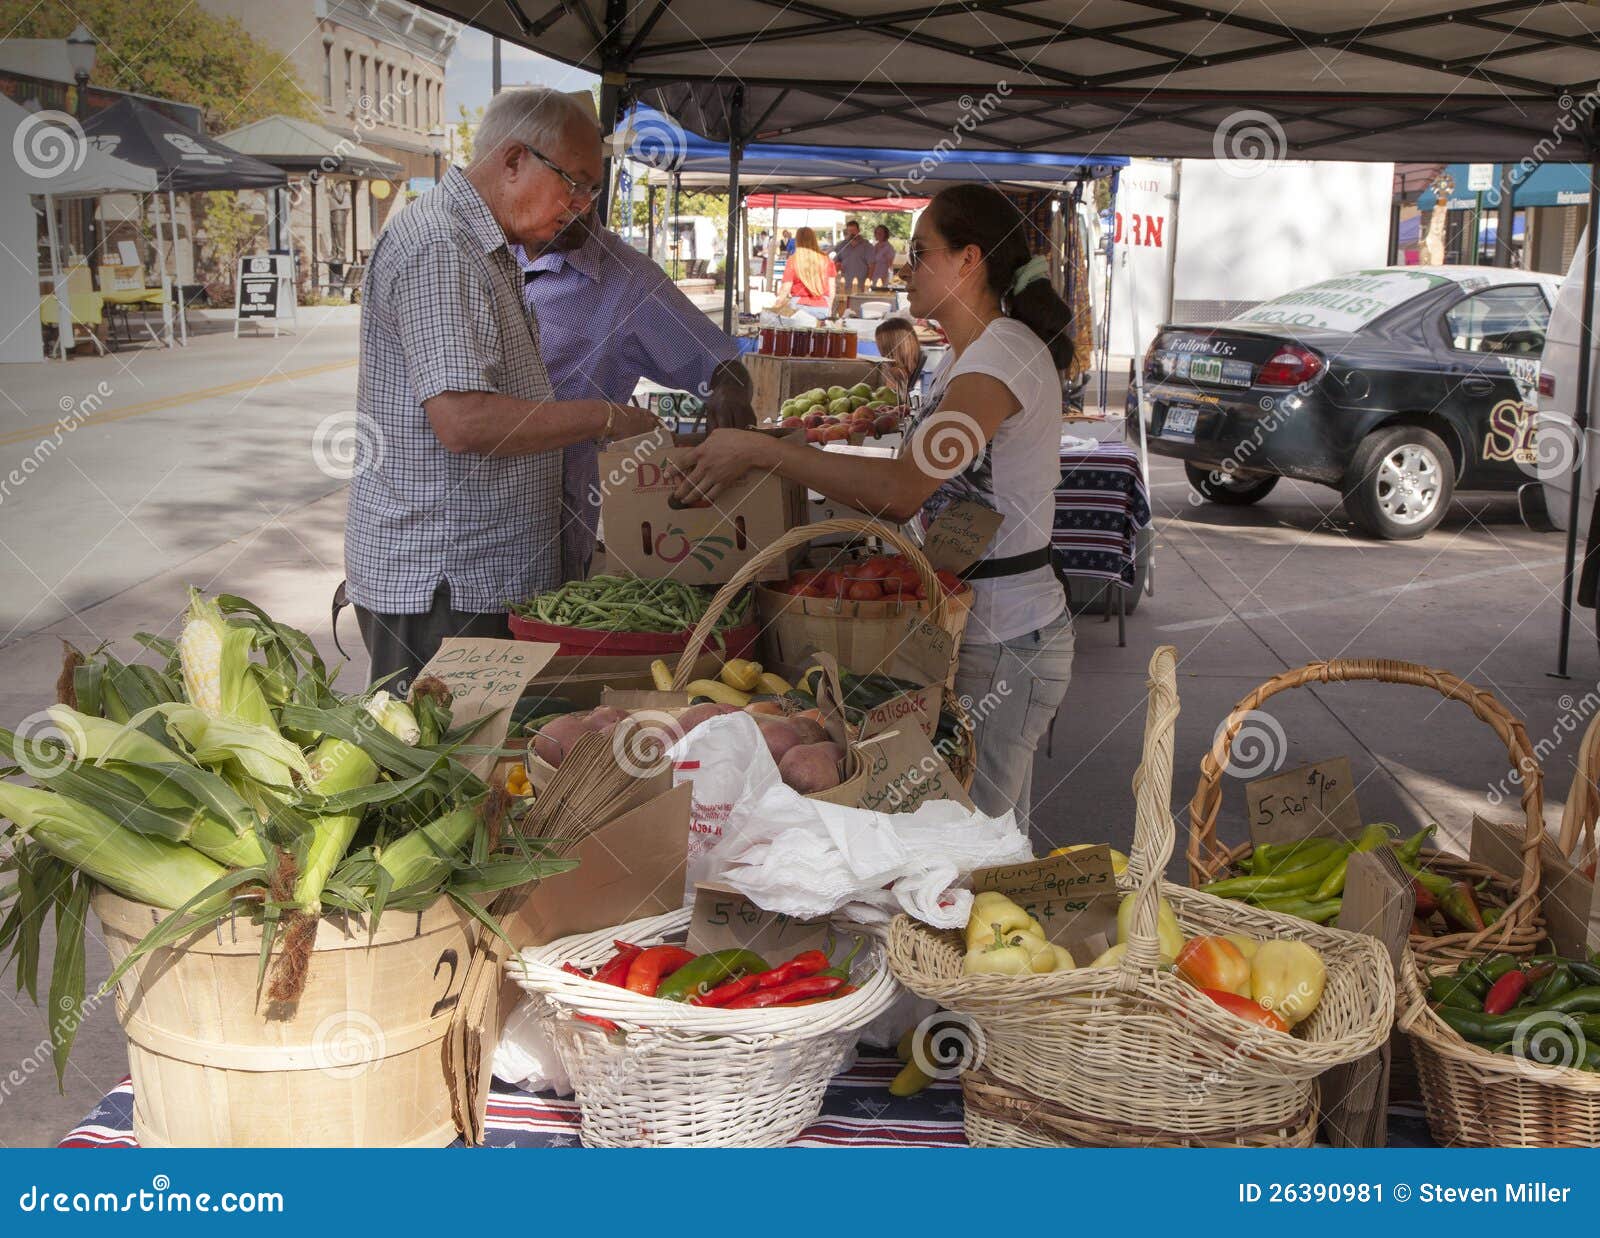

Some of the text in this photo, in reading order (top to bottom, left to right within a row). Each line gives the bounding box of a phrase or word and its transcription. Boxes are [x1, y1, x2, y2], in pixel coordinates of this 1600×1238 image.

[1170, 339, 1211, 353] Follow
[1257, 794, 1275, 826] 5
[430, 947, 461, 1019] 2
